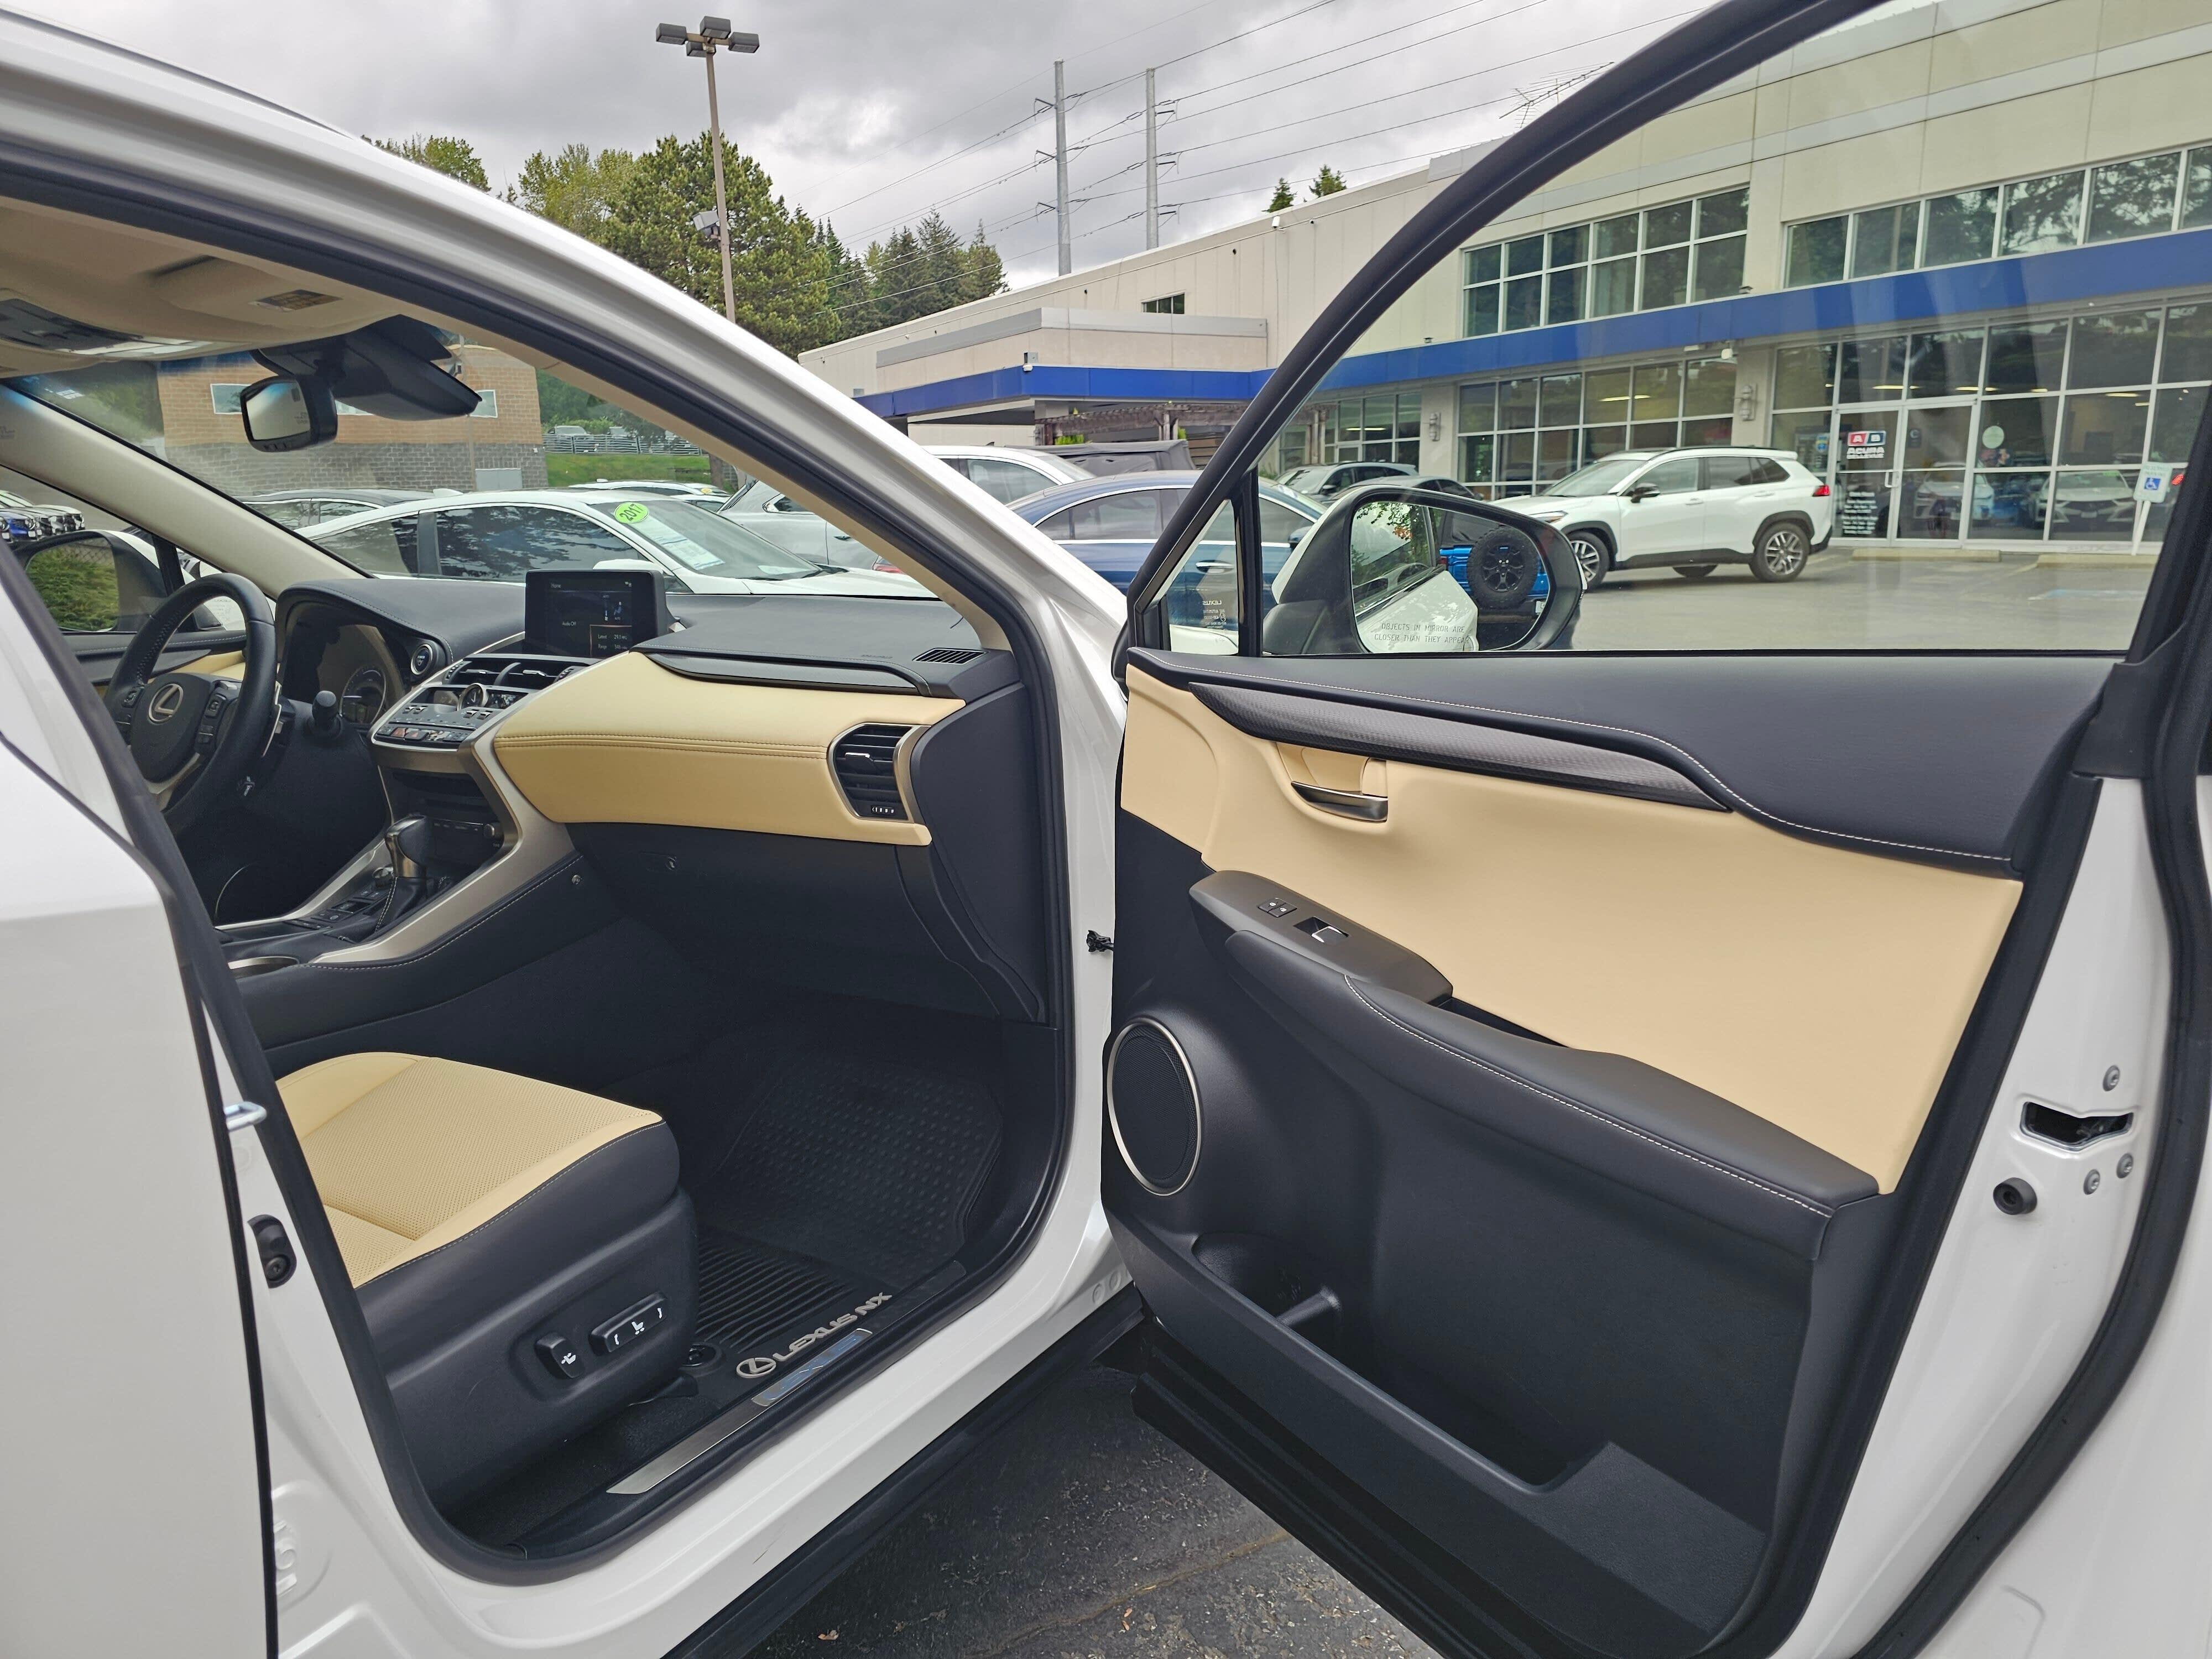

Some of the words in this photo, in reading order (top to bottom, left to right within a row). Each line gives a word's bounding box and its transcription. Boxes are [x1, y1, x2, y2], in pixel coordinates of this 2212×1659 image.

[619, 504, 643, 521] 2017
[1381, 623, 1410, 631] OBJECTS
[773, 1313, 858, 1361] LEXUS
[855, 1292, 892, 1316] NX
